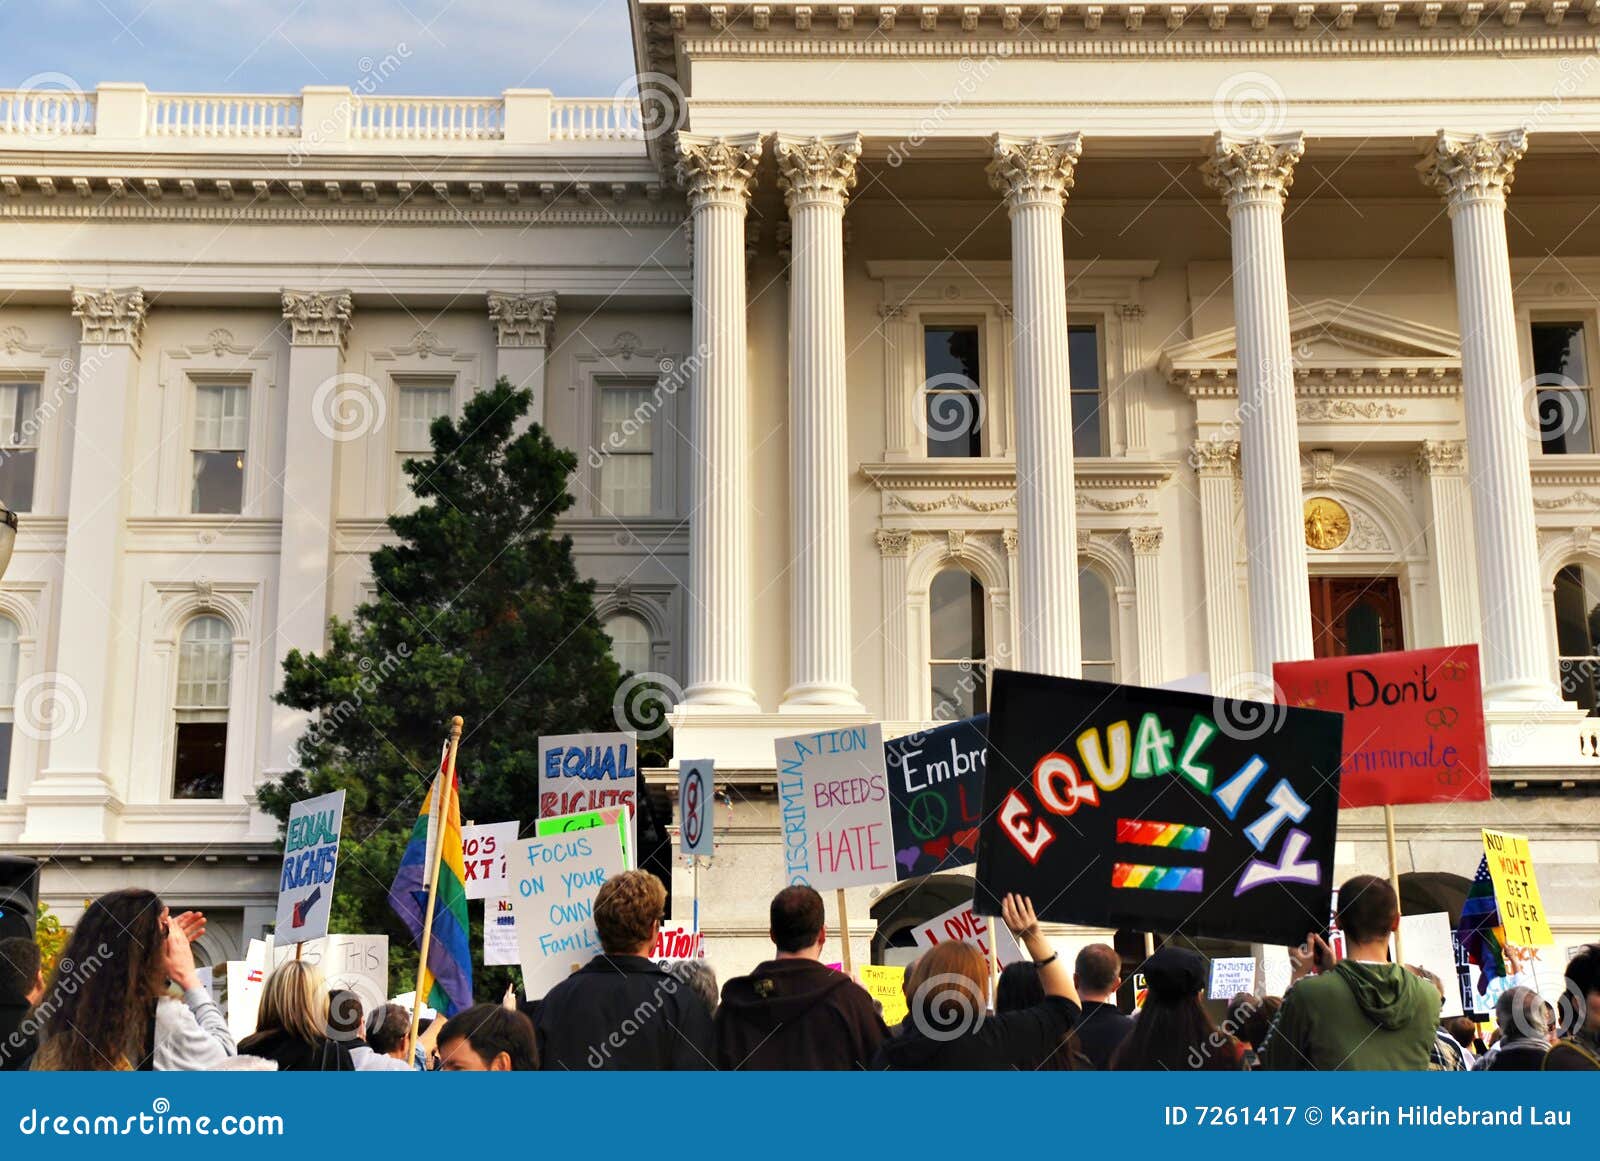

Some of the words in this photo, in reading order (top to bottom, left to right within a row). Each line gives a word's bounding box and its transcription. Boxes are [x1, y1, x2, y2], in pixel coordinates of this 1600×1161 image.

[1347, 664, 1437, 710] Don't
[545, 744, 636, 780] EQUAL
[902, 738, 987, 793] Embr
[1340, 736, 1458, 774] criminate
[814, 775, 885, 809] BREEDS
[997, 713, 1321, 896] EQUALITY
[287, 809, 338, 853] EQUAL
[816, 823, 888, 873] HATE
[281, 845, 337, 892] RIGHTS
[520, 877, 545, 897] ON
[561, 867, 609, 897] YOUR
[1506, 879, 1529, 899] GET
[550, 898, 592, 926] OWN
[337, 941, 380, 971] THIS
